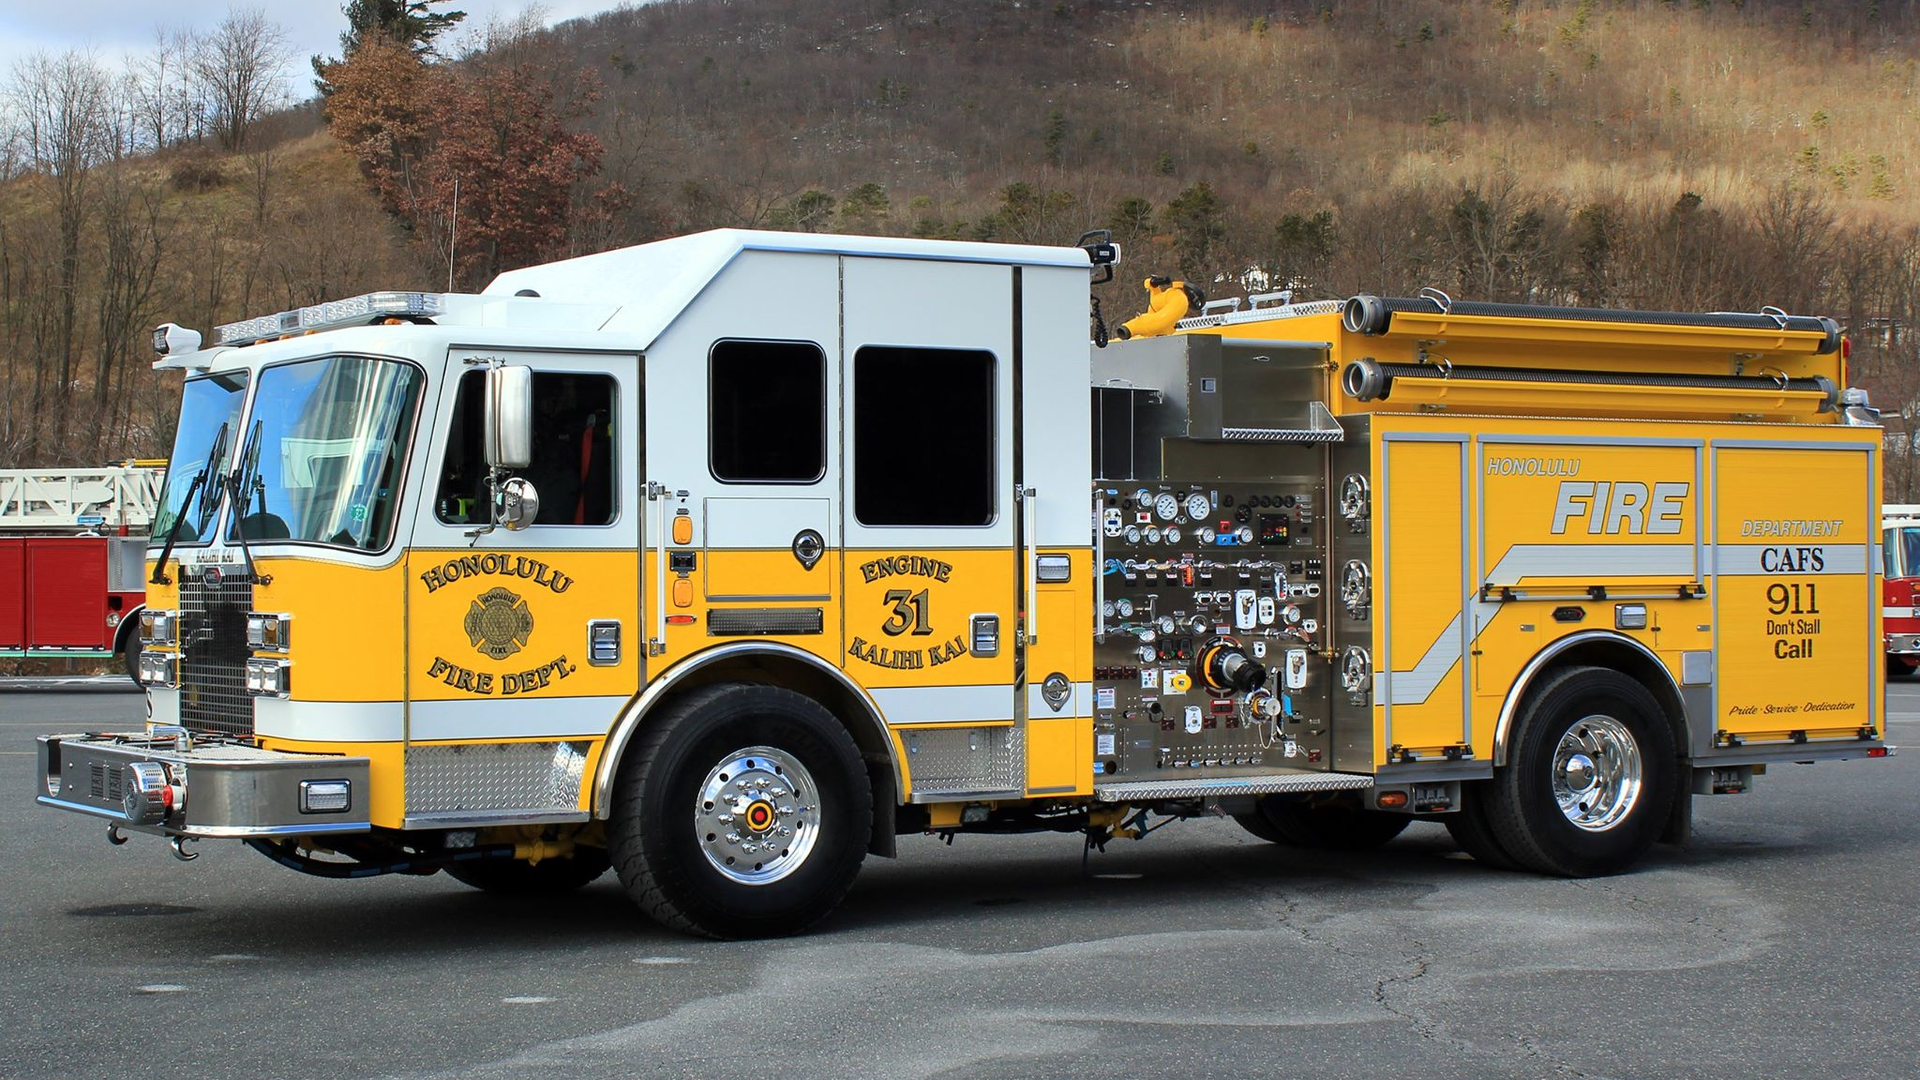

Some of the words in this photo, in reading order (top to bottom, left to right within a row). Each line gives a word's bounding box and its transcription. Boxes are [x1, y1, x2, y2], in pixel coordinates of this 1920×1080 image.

[1486, 457, 1581, 477] HONOLULU
[1550, 480, 1690, 535] FIRE
[1740, 520, 1843, 537] DEPARTMENT
[420, 553, 574, 593] HONOLULU
[859, 555, 953, 584] ENGINE
[1761, 547, 1825, 572] CAFS
[881, 588, 934, 637] 31
[1766, 583, 1820, 615] 911
[1766, 619, 1796, 636] Don't
[1797, 619, 1820, 635] Stall
[848, 636, 924, 670] KALIHI
[929, 635, 967, 667] KAI
[1774, 638, 1813, 660] Call
[427, 656, 494, 695] FIRE
[501, 654, 577, 695] DEPT.
[1728, 705, 1758, 716] Pride
[1763, 703, 1799, 715] Service
[1803, 701, 1856, 713] Dedication
